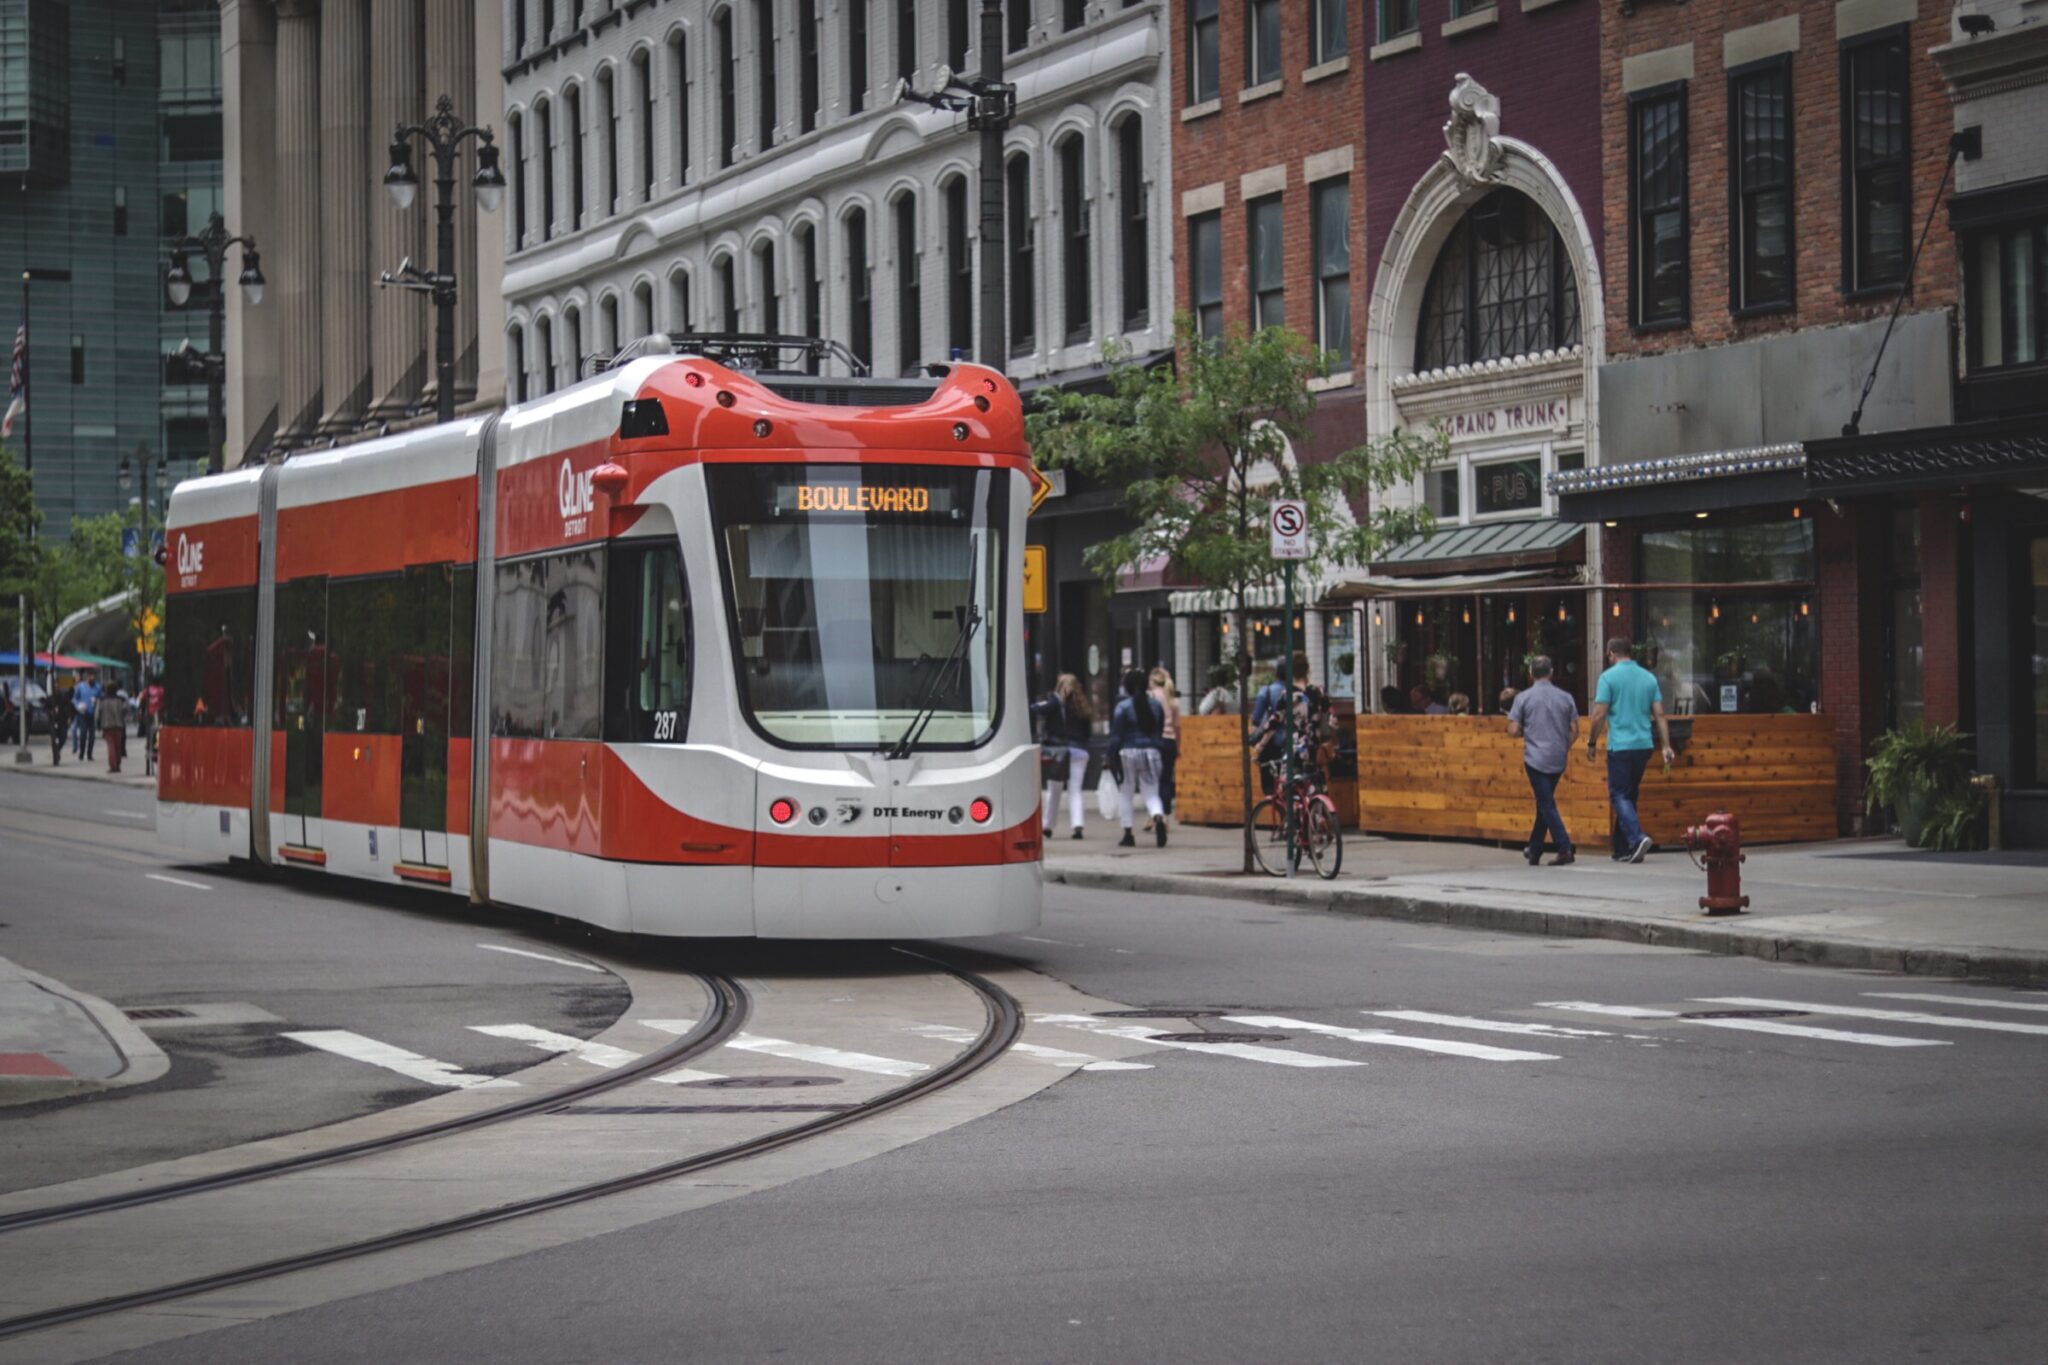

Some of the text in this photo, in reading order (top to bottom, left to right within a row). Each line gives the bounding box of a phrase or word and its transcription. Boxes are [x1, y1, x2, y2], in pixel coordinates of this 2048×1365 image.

[1446, 400, 1559, 437] GRAND TRUNK
[559, 458, 594, 519] QLINE
[798, 486, 929, 512] BOULEVARD
[1492, 472, 1527, 503] PUB
[564, 517, 587, 538] DETROIT
[177, 532, 204, 576] QLINE
[653, 711, 677, 740] 287
[873, 807, 944, 820] DTE Energy
